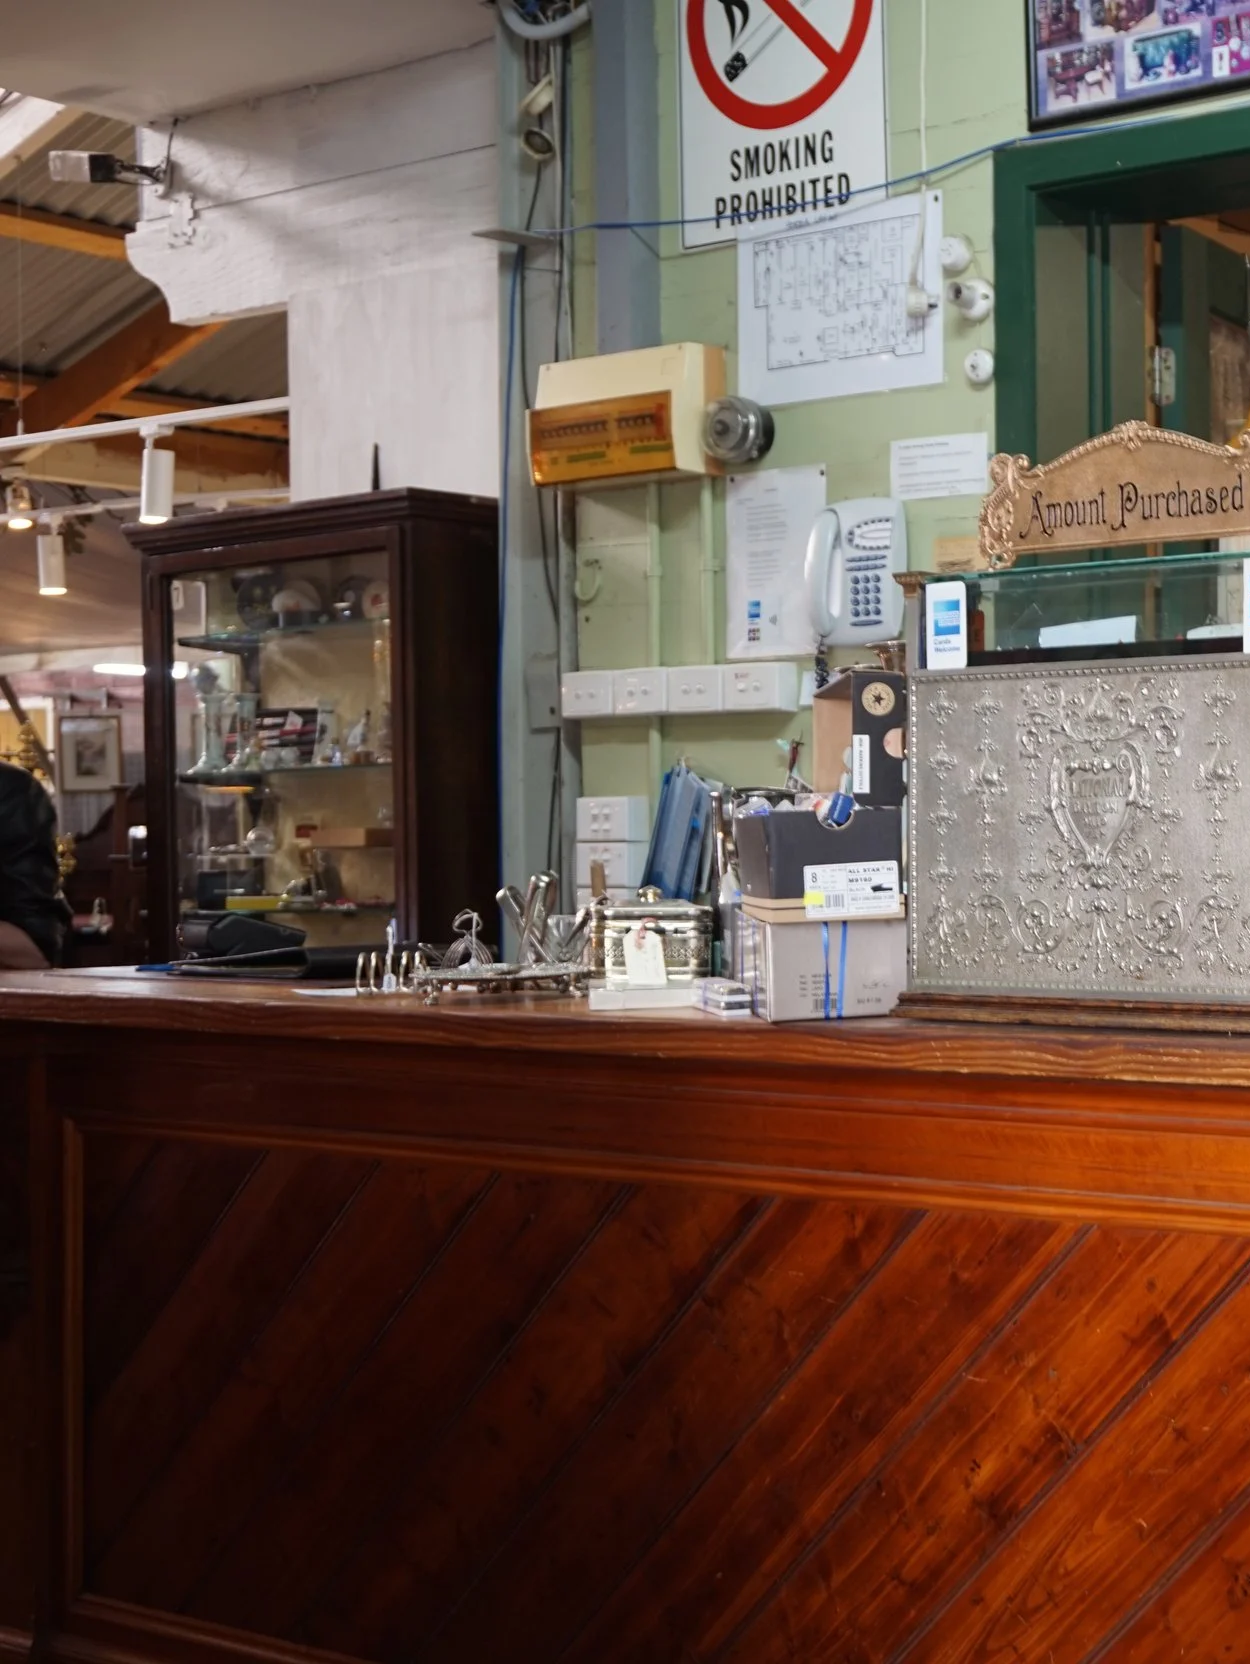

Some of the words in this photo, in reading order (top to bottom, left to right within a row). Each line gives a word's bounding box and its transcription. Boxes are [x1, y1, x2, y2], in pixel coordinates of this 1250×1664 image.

[730, 129, 834, 182] SMOKING
[715, 172, 851, 229] PROHIBITED
[1019, 487, 1107, 539] Amount
[1110, 474, 1245, 531] Purchased
[811, 872, 818, 883] 8
